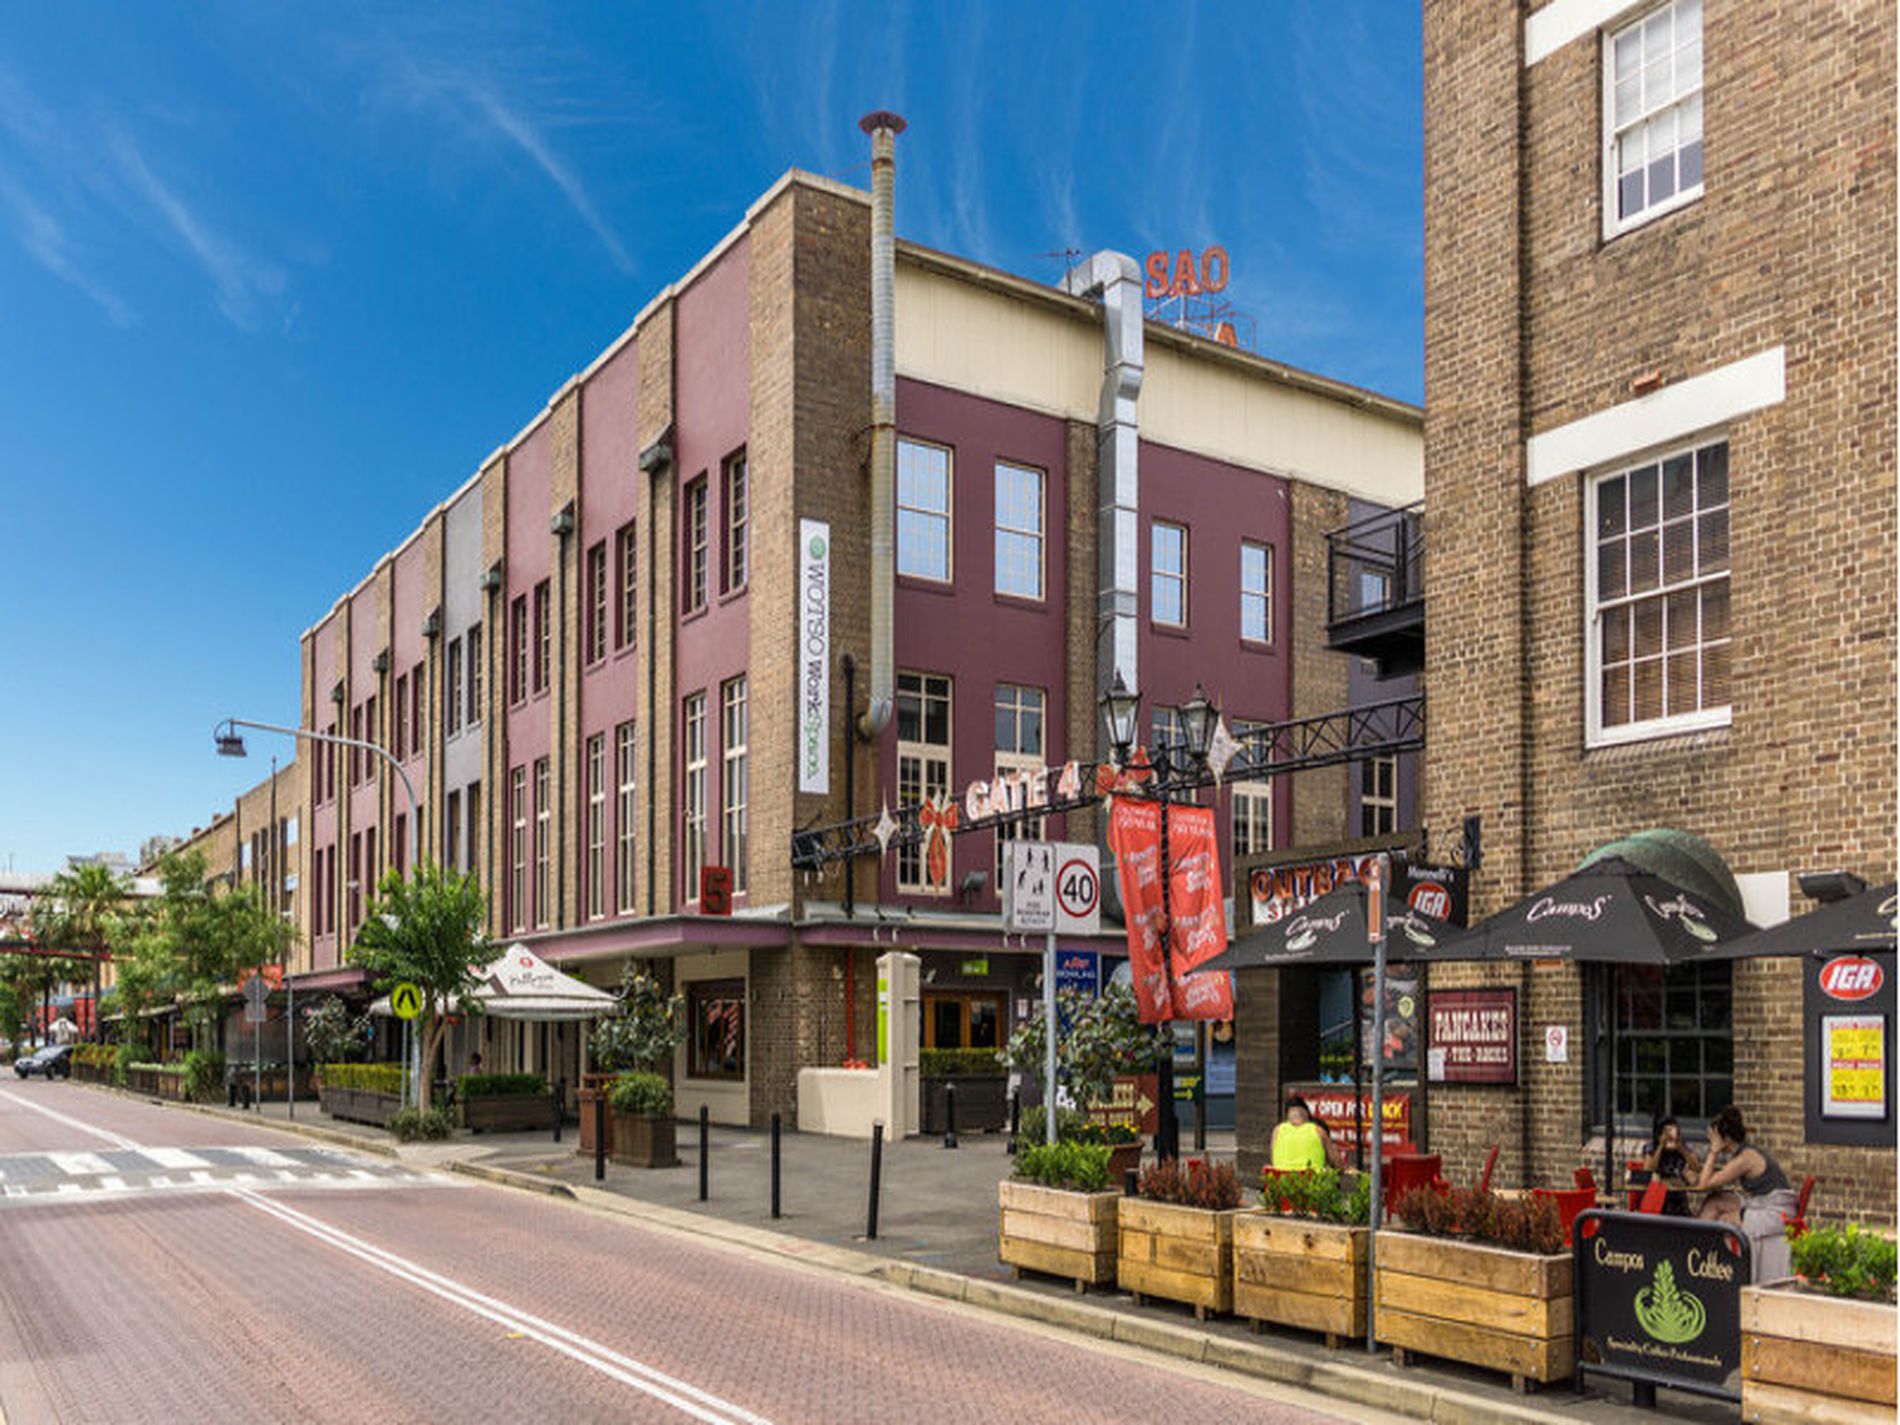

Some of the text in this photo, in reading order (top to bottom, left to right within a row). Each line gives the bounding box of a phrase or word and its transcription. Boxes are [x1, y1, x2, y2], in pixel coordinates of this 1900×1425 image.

[1145, 245, 1229, 299] SAO
[807, 562, 825, 656] WOTSO
[966, 760, 1081, 820] GATE 4
[705, 871, 728, 913] 5
[1063, 874, 1093, 903] 40
[1251, 855, 1392, 902] OUTBAC
[1415, 890, 1447, 917] IGA
[1827, 964, 1877, 990] IGA
[1435, 1010, 1507, 1042] PANCAKES
[1595, 1237, 1733, 1281] Campos Coffee
